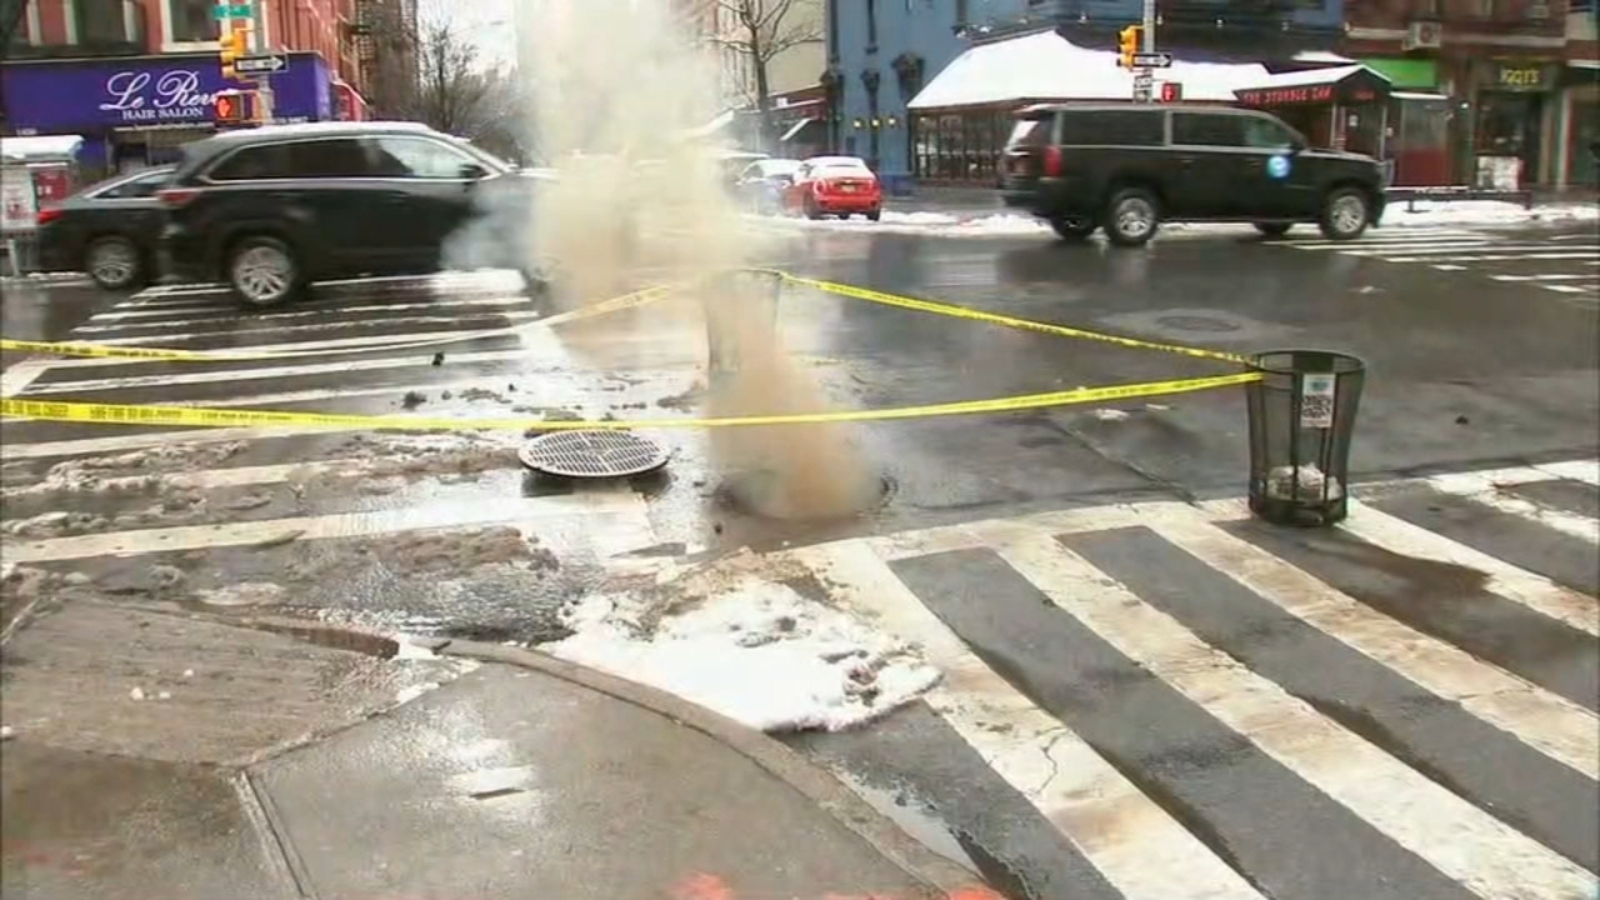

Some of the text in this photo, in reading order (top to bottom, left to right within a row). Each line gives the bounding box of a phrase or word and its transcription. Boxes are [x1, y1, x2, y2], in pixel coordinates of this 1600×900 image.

[99, 71, 150, 110] Le
[122, 107, 204, 120] HAIR SALON
